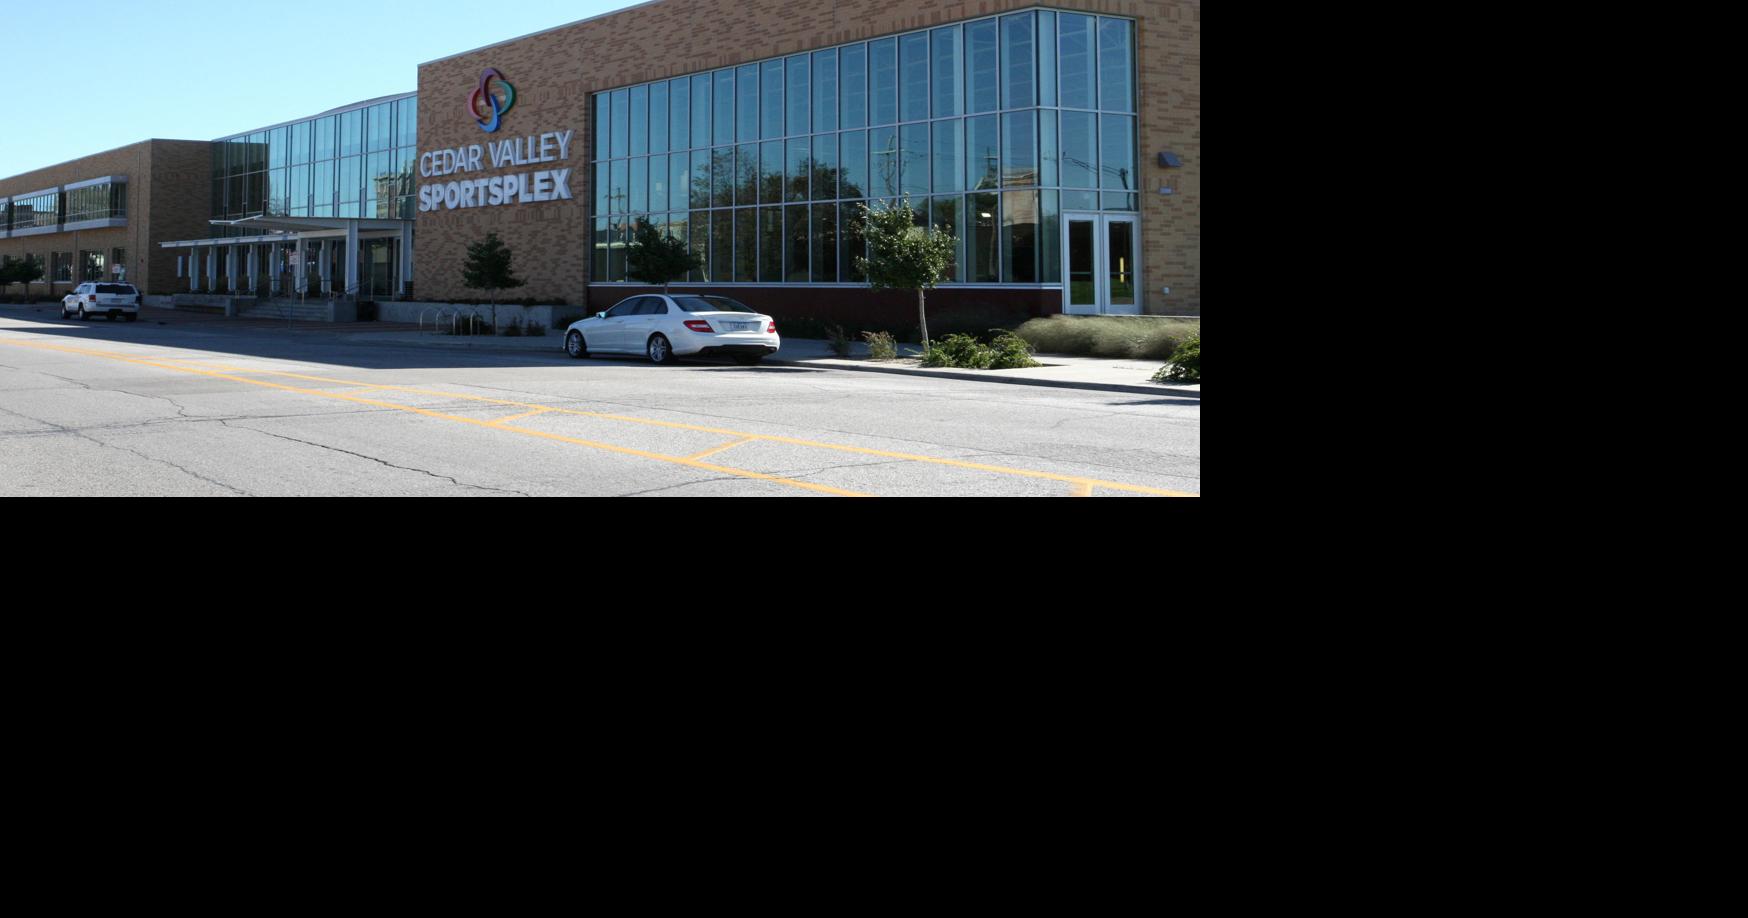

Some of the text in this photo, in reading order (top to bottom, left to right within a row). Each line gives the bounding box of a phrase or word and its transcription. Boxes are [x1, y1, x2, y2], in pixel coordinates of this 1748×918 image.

[420, 130, 572, 177] CEDAR VALLEY
[419, 168, 573, 212] SPORTSPLEX
